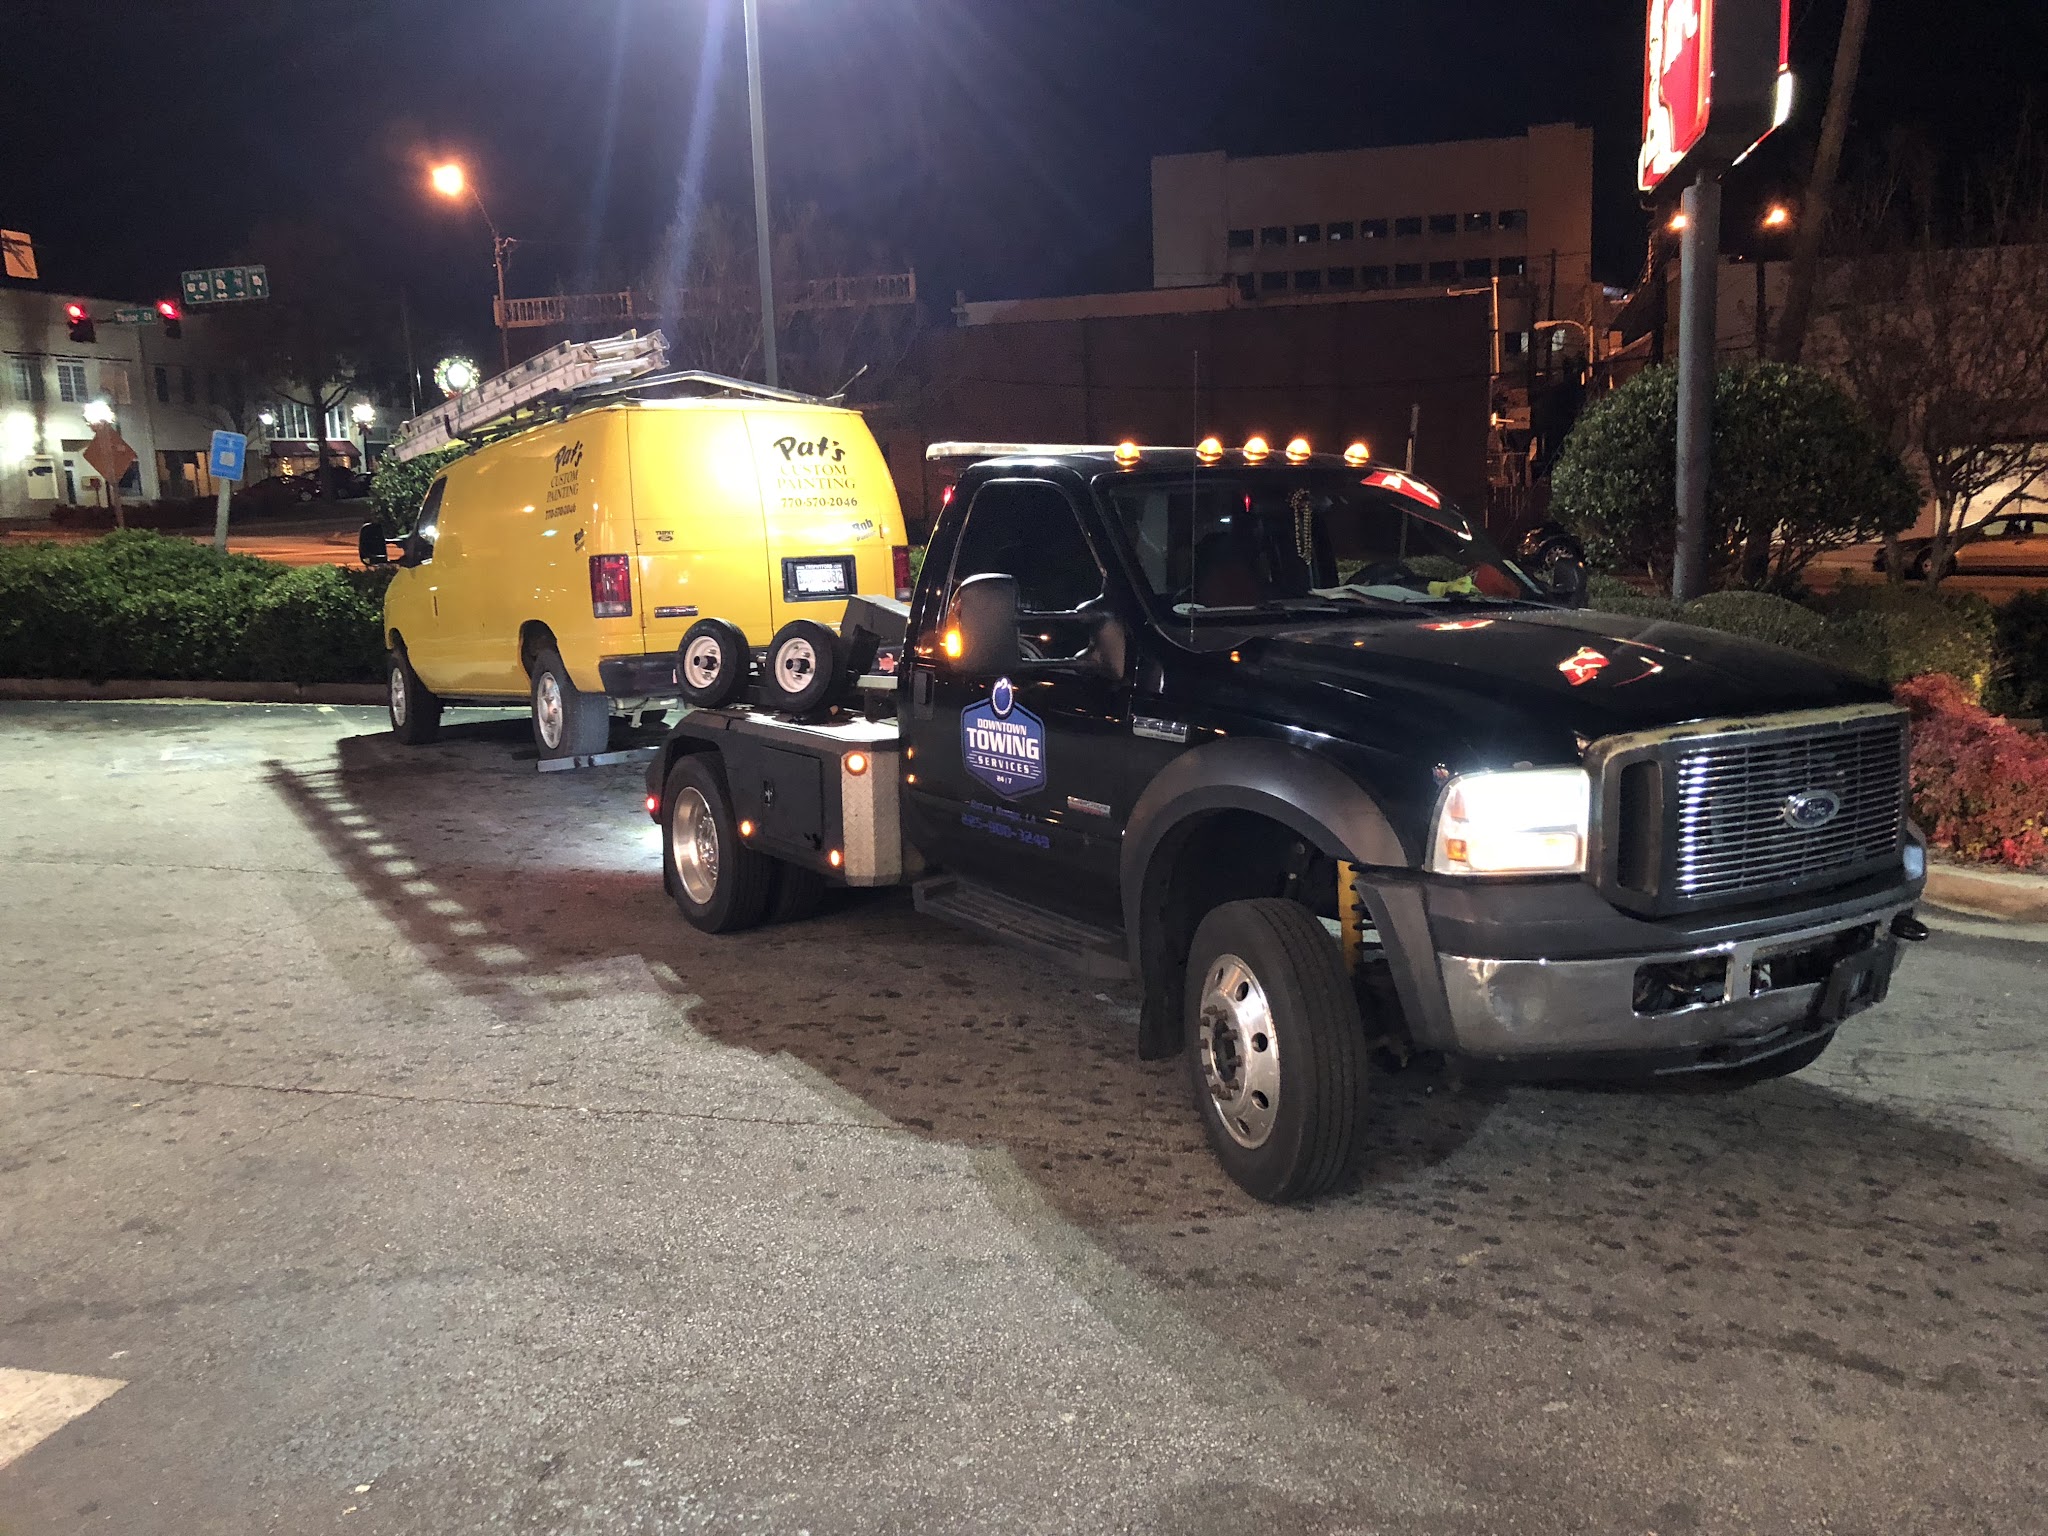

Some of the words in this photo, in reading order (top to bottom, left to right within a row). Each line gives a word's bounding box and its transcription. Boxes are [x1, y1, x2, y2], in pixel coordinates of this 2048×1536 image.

[554, 440, 584, 473] Pat's
[773, 436, 846, 462] Pat's
[550, 469, 579, 488] CUSTOM
[780, 463, 848, 476] CUSTOM
[546, 483, 579, 503] PAINTING
[777, 478, 856, 490] PAINTING
[977, 718, 1027, 736] DOWNTOWN
[966, 727, 1040, 760] TOWING
[977, 755, 1030, 774] SERVICES
